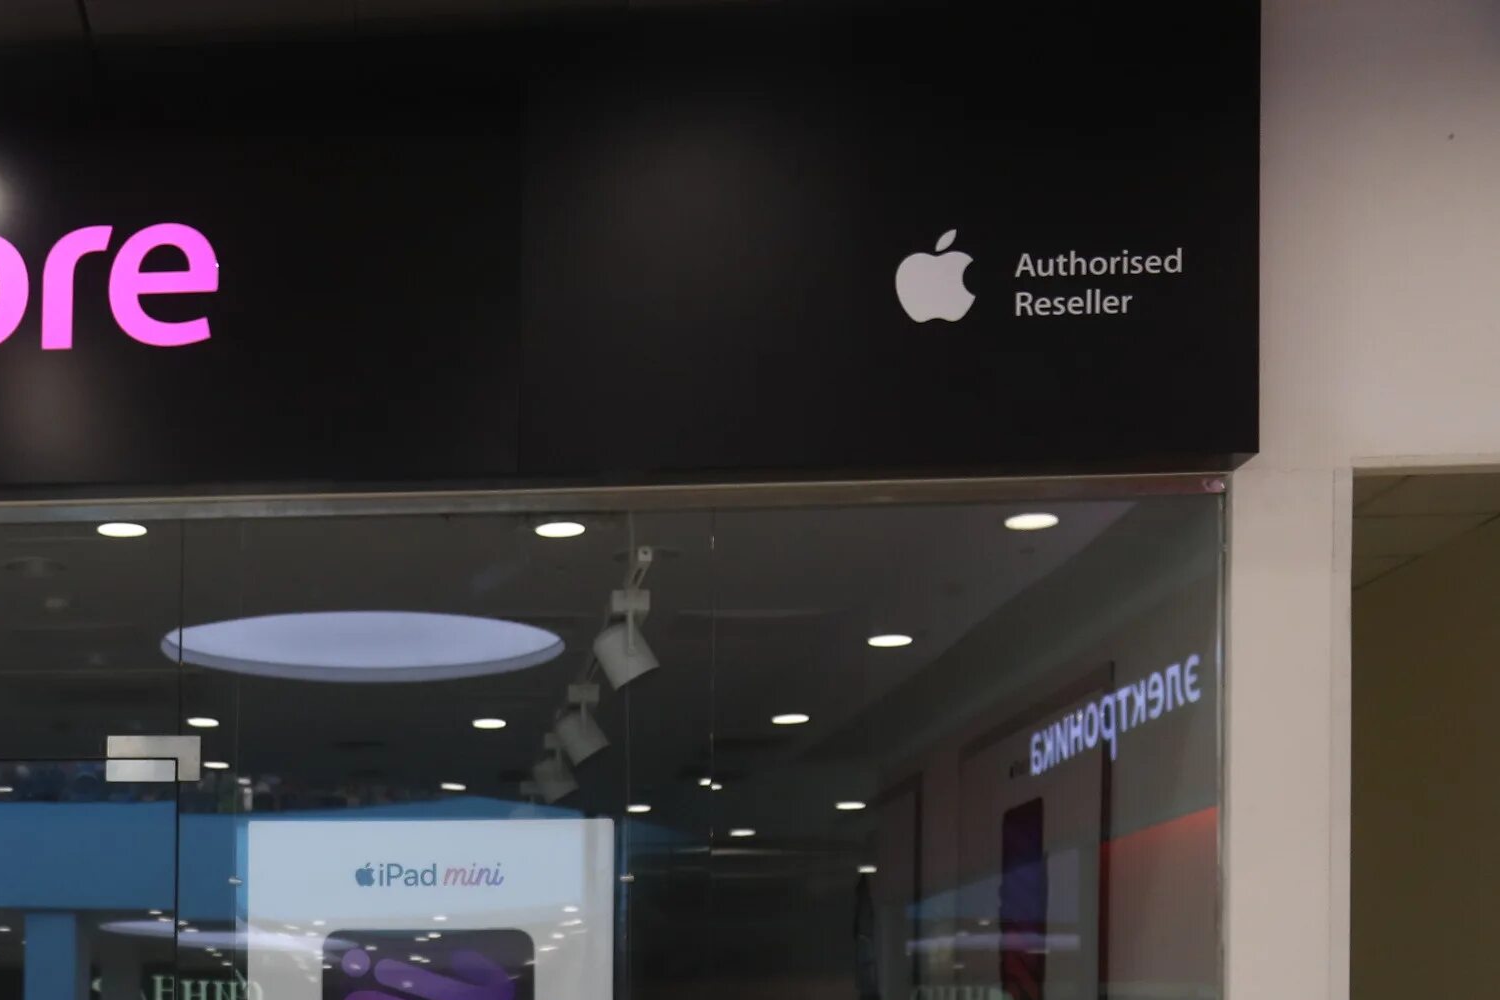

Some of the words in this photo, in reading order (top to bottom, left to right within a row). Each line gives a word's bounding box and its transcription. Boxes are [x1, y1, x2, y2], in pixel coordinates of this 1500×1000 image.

[1015, 248, 1183, 277] Authorised
[1015, 289, 1133, 316] Reseller
[379, 863, 438, 887] iPad
[443, 863, 505, 887] mini
